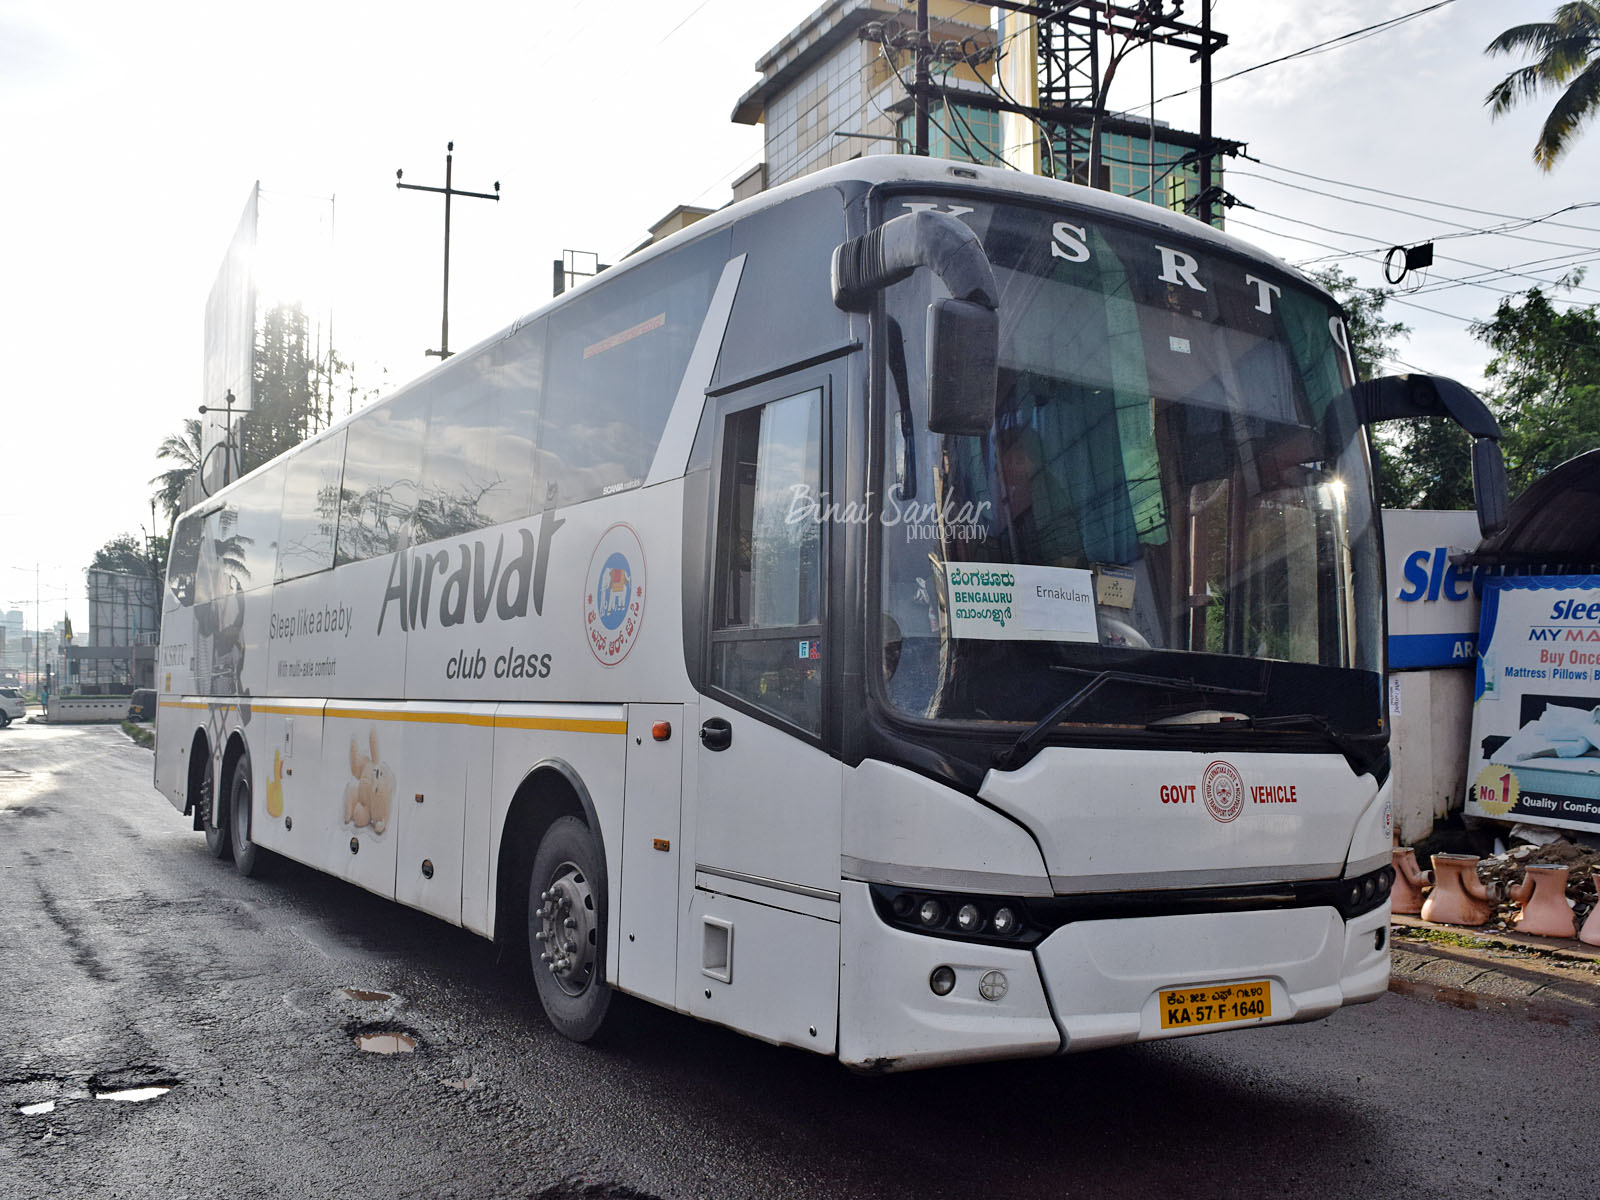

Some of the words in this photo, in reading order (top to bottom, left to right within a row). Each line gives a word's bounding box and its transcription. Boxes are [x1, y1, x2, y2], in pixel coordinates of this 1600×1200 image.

[955, 592, 1013, 604] BENGALURU
[1036, 586, 1090, 604] Ernakulam
[1550, 599, 1600, 623] Slee
[270, 612, 296, 643] Sleep
[297, 607, 315, 637] like
[316, 611, 323, 633] a
[324, 601, 353, 638] baby.
[1528, 628, 1562, 641] MY
[446, 648, 487, 680] club
[494, 646, 552, 679] class
[1540, 649, 1565, 667] Buy
[1504, 666, 1547, 679] Mattress
[1552, 668, 1588, 680] Pillows
[1160, 785, 1196, 804] GOVT
[1250, 785, 1297, 804] VEHICLE
[1522, 796, 1558, 811] Quality
